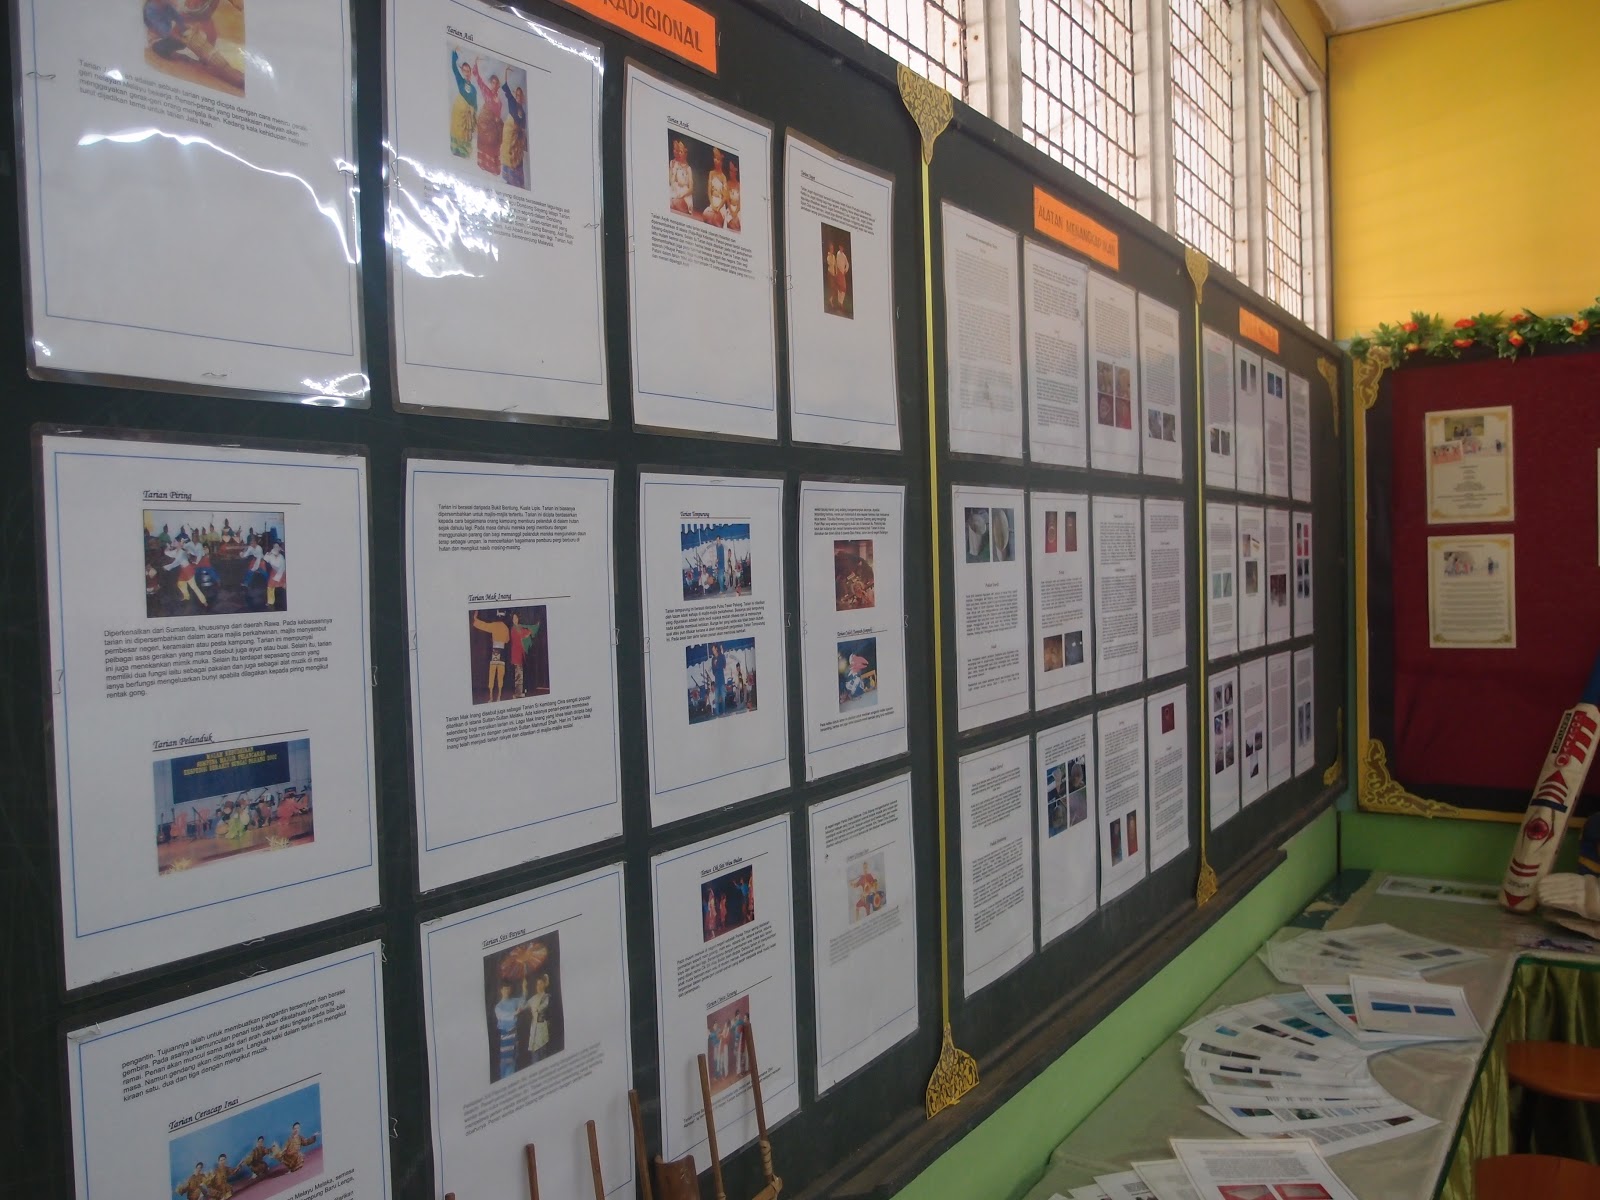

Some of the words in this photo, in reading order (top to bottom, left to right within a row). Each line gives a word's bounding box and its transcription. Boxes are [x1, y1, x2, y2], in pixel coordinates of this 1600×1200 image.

[143, 490, 168, 499] Tarian
[107, 690, 128, 698] rentak
[128, 690, 147, 698] gong.
[153, 740, 178, 749] Tarian
[179, 733, 214, 745] Pelanduk
[169, 1117, 192, 1130] Tarian
